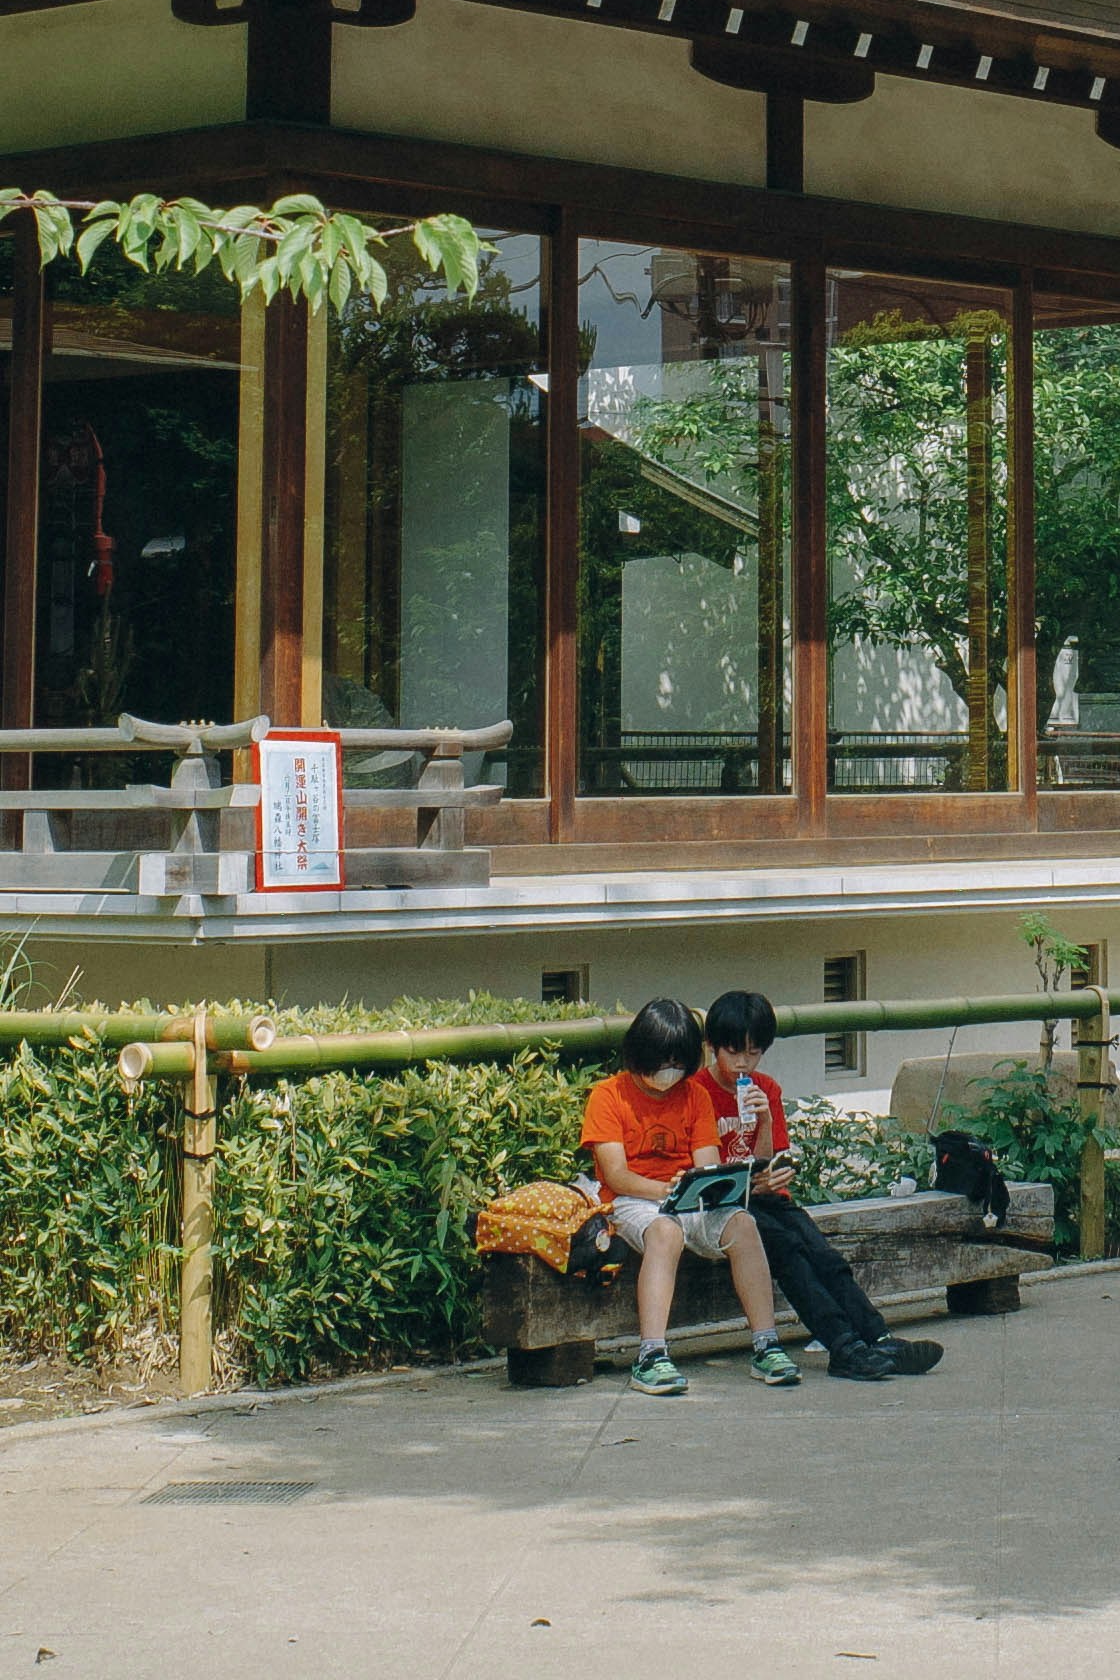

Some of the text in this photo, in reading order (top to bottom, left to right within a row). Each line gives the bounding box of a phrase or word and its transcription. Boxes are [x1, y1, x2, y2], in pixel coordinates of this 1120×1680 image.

[294, 758, 308, 871] 開運山開き大祭
